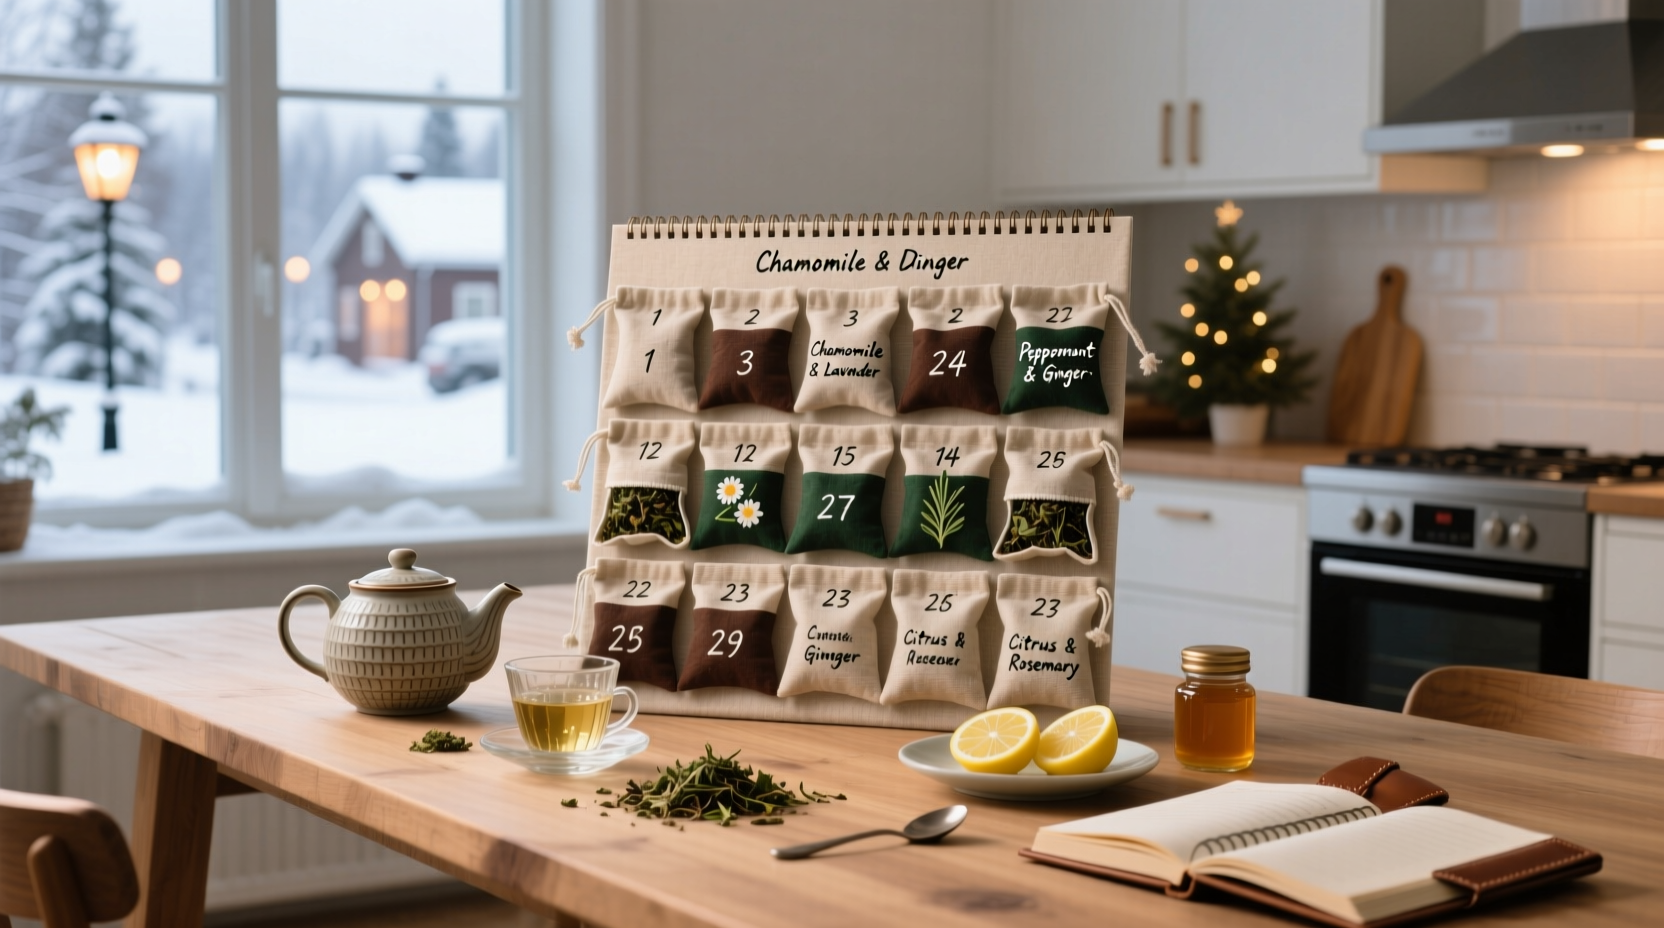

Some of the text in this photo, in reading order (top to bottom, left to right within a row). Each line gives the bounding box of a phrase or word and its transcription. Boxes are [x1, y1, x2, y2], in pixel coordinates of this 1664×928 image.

[756, 248, 969, 280] Chamomile & Dinger
[652, 309, 662, 326] 1
[744, 308, 760, 325] 2
[843, 309, 858, 327] 3
[947, 307, 963, 324] 2
[645, 348, 656, 374] 1
[736, 350, 754, 376] 3
[809, 362, 819, 377] &
[928, 350, 967, 377] 24
[1023, 365, 1036, 382] &
[639, 441, 663, 460] 12
[734, 443, 757, 463] 12
[833, 445, 857, 467] 15
[936, 446, 961, 468] 14
[817, 493, 856, 522] 27
[622, 580, 652, 598] 22
[720, 583, 750, 603] 23
[822, 588, 852, 608] 23
[1030, 597, 1061, 618] 23
[707, 629, 744, 658] 29
[903, 628, 966, 649] Citrus &
[1008, 633, 1077, 654] Citrus &
[1008, 653, 1080, 680] Rosemary
